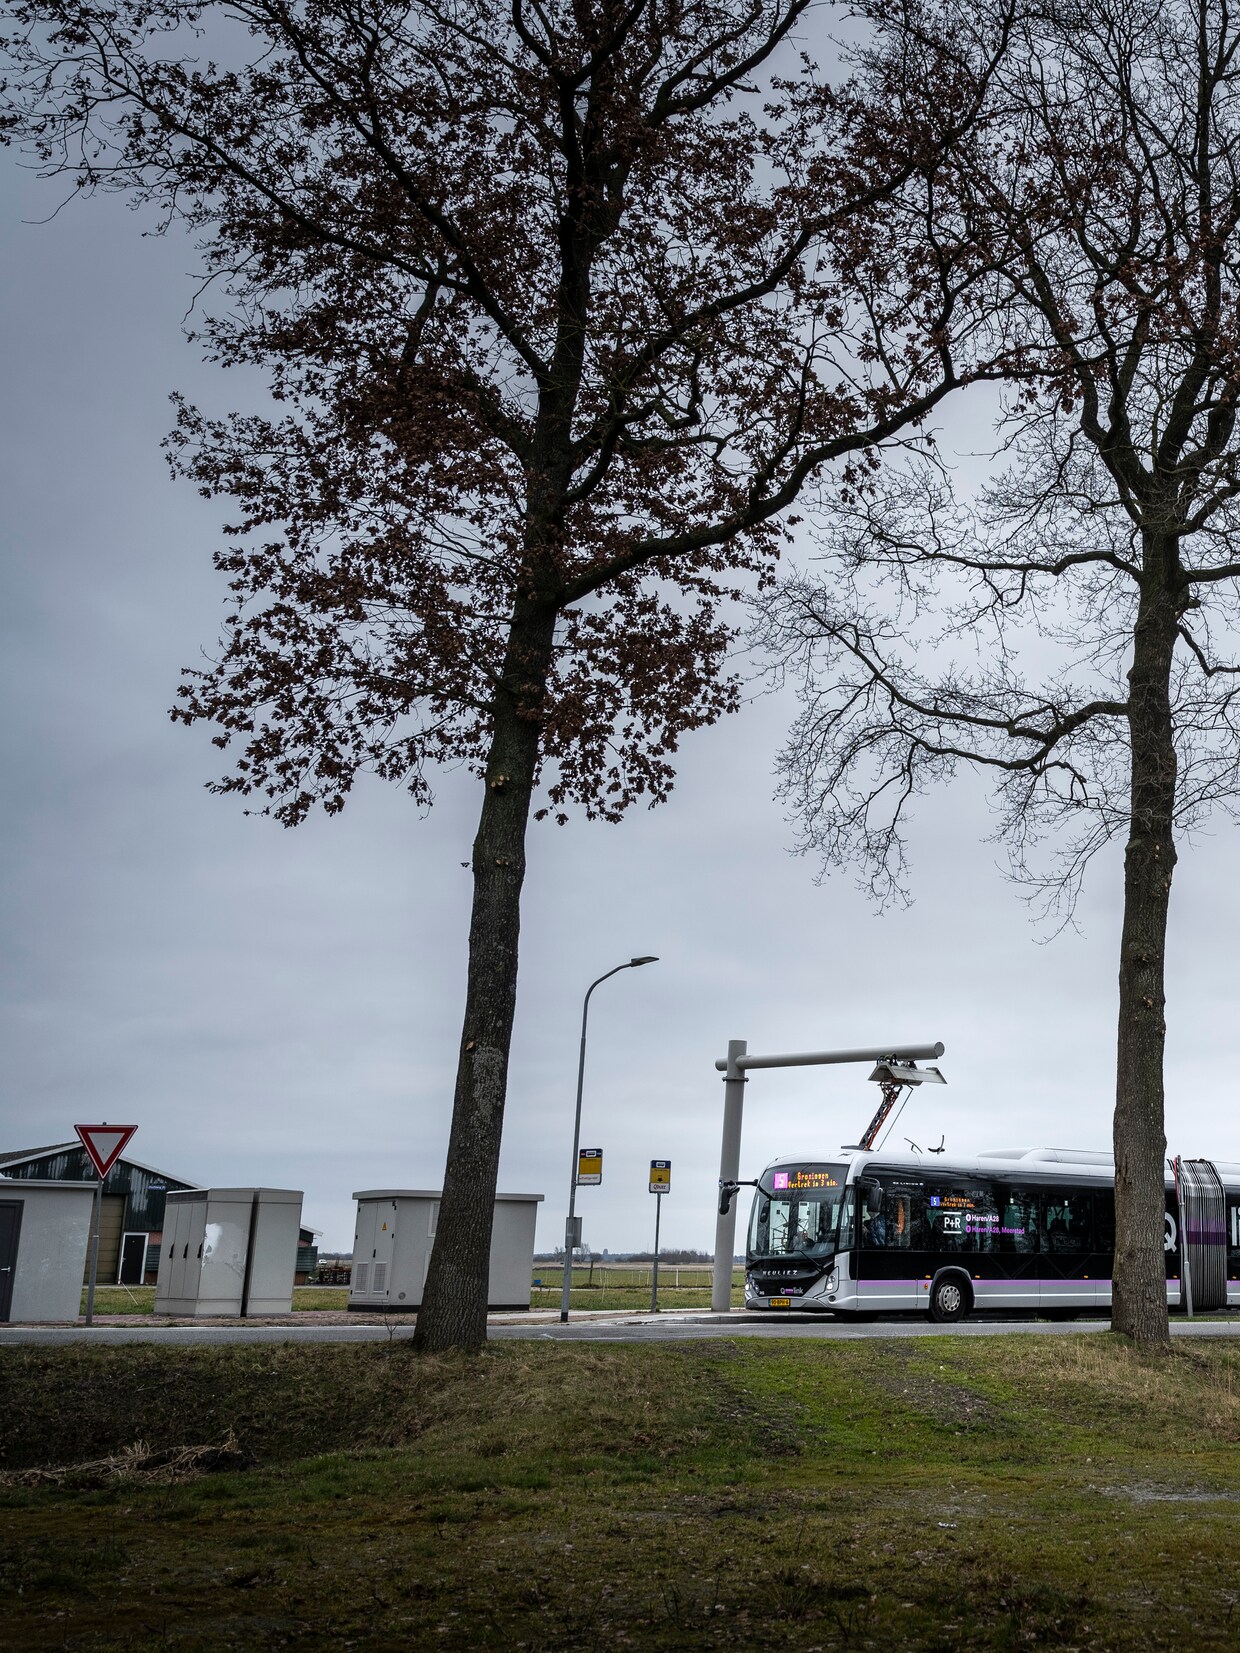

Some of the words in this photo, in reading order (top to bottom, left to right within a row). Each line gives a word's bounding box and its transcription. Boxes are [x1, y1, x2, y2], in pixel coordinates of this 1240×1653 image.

[797, 1171, 829, 1180] Groningen
[779, 1174, 785, 1187] 5
[971, 1214, 1000, 1222] Haren/A28
[944, 1217, 961, 1229] P+R
[1001, 1227, 1025, 1235] Meerstad
